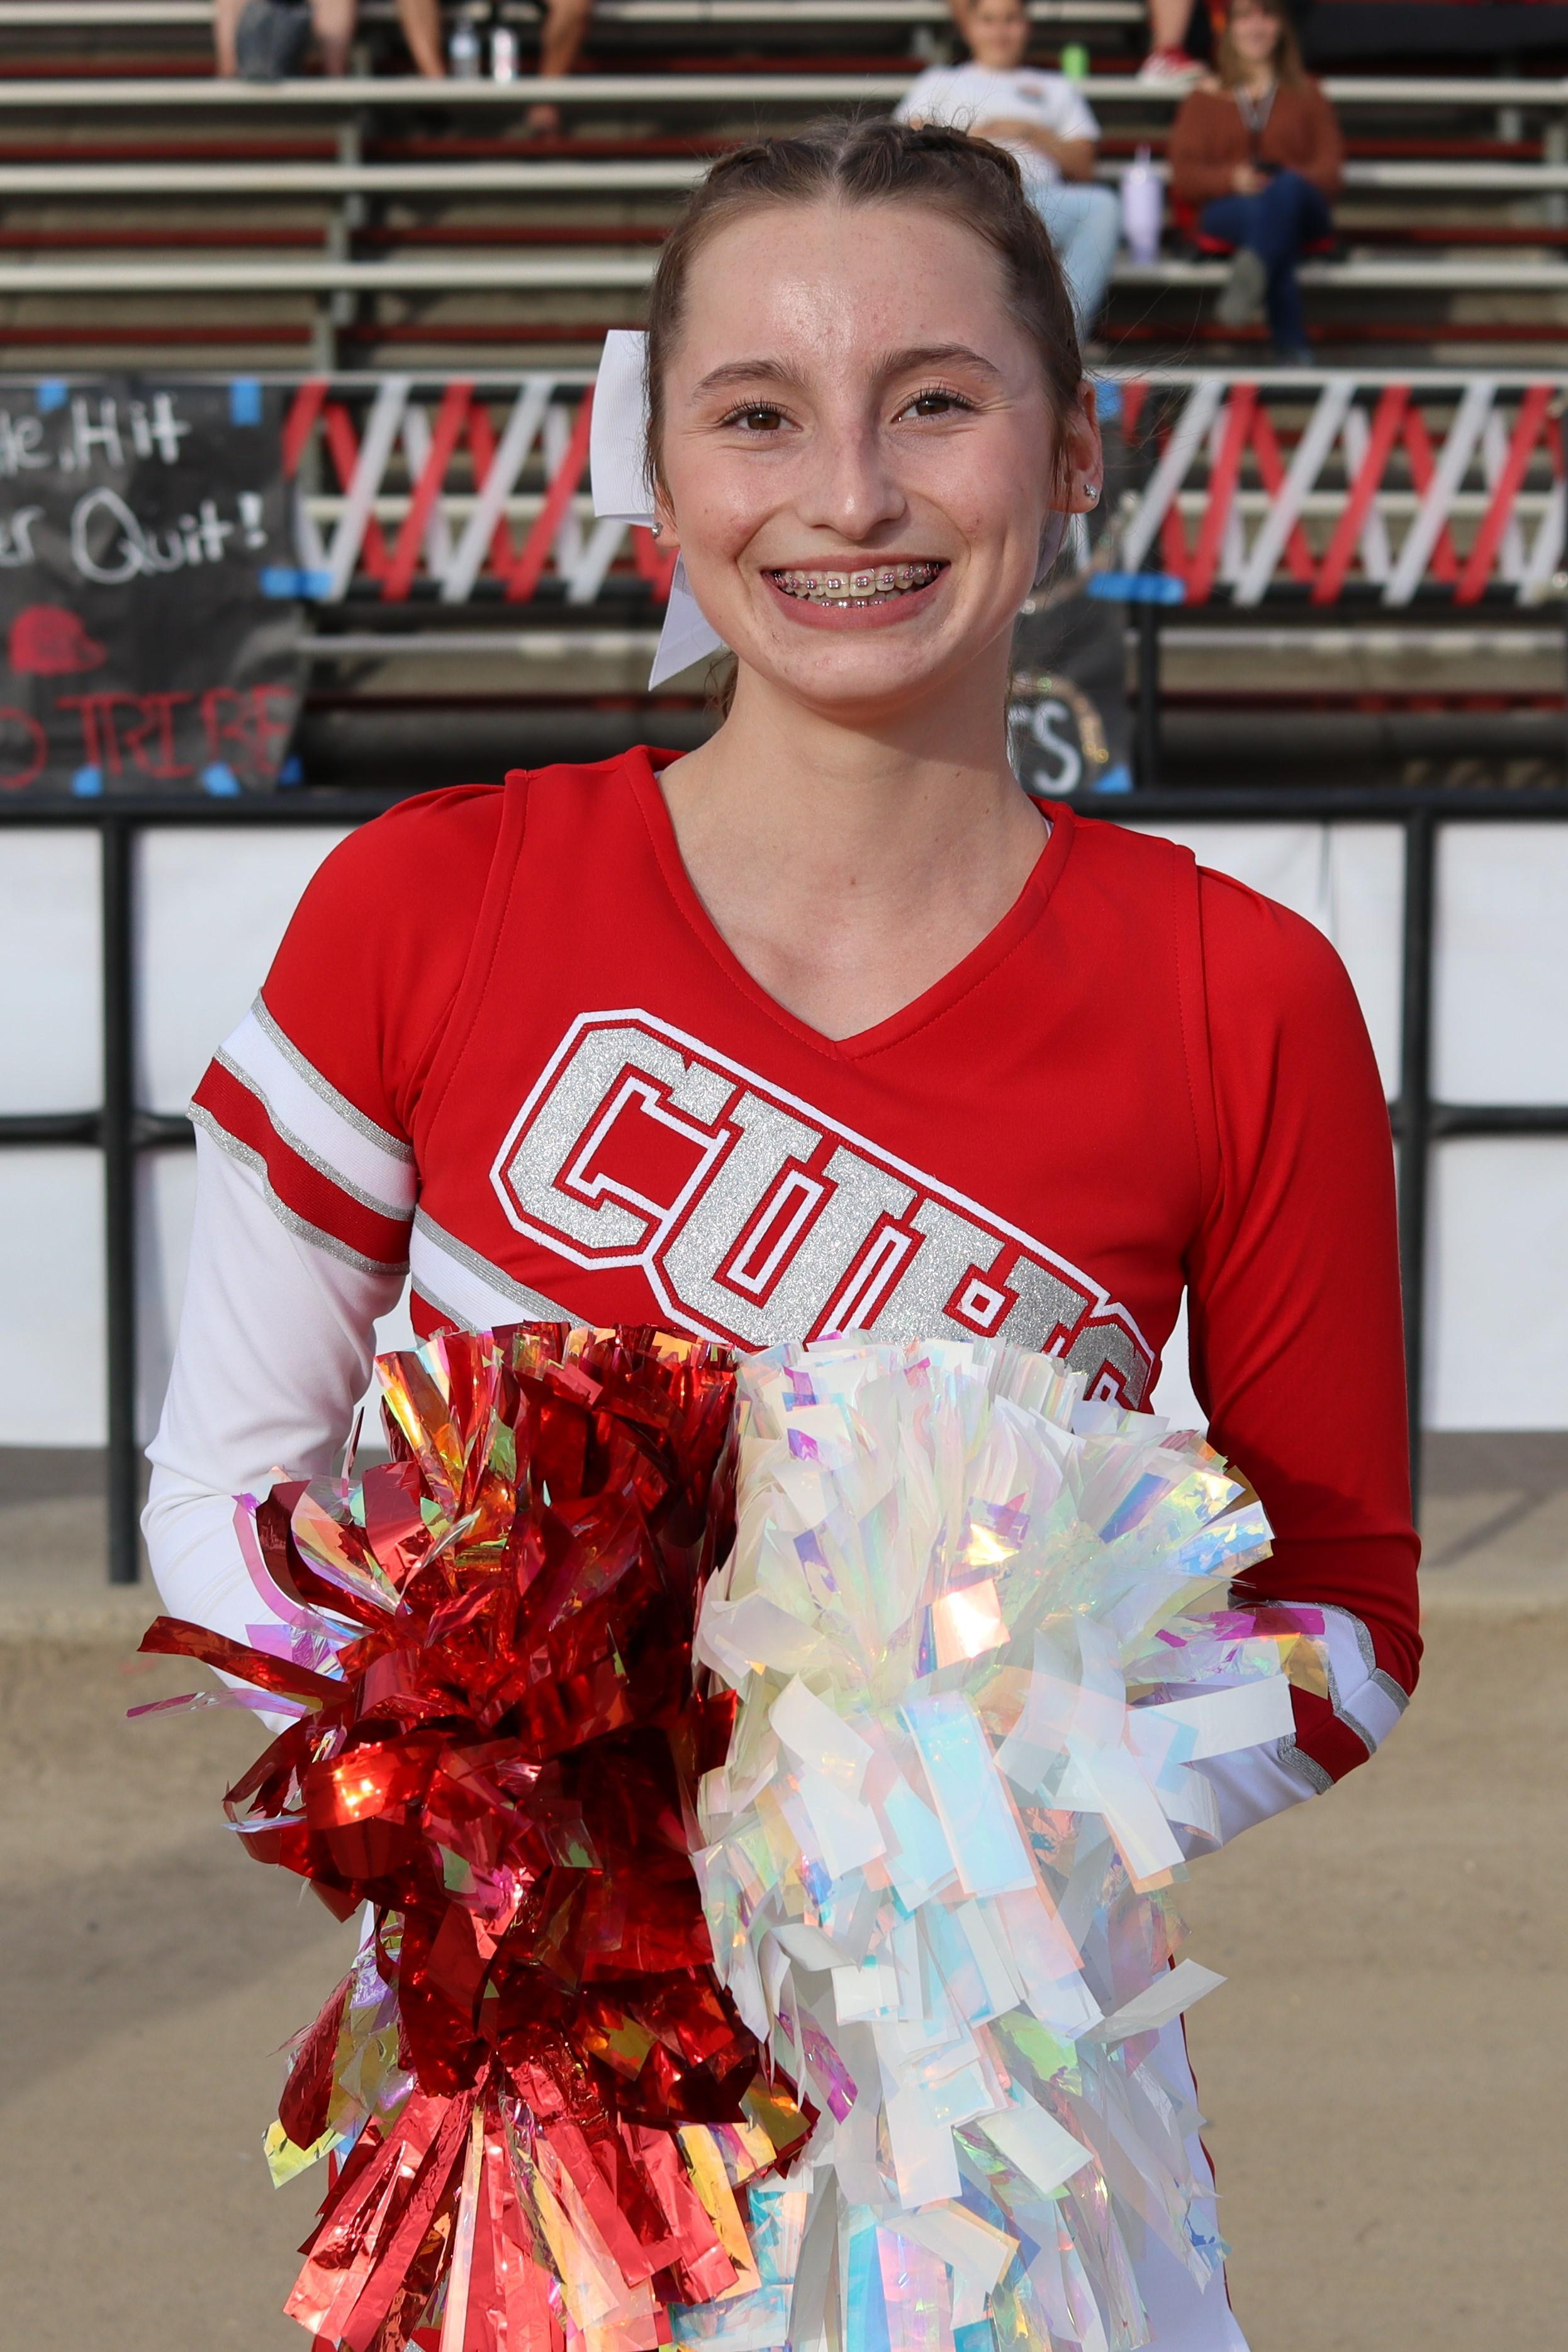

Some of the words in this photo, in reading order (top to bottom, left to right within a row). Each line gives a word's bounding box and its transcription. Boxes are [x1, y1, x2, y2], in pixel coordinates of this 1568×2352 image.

[72, 393, 191, 471] Hit
[71, 487, 267, 585] Quit!
[55, 684, 293, 779] TRIBE
